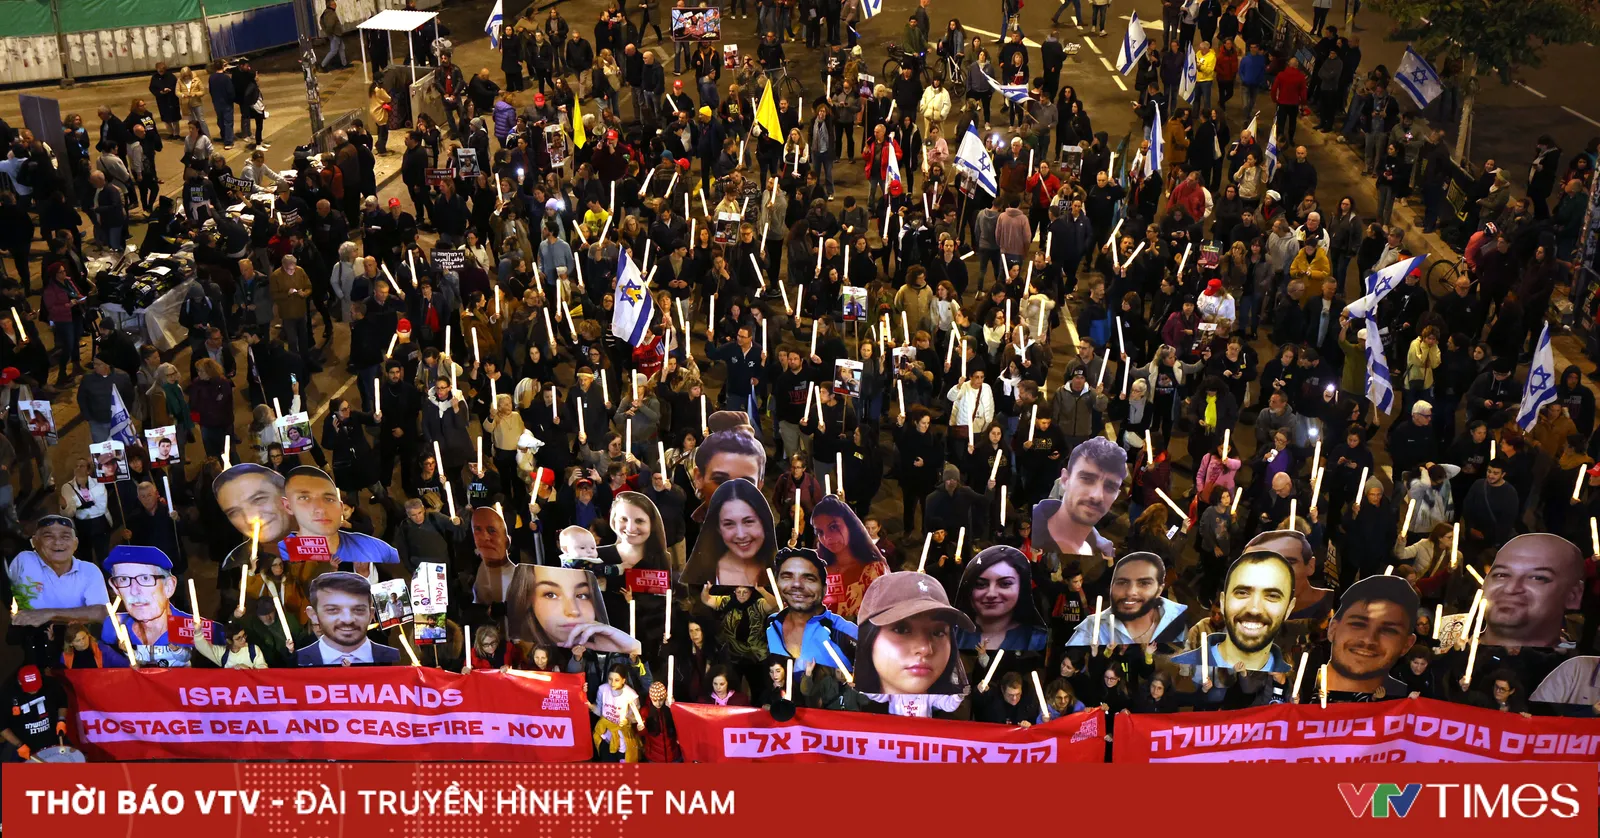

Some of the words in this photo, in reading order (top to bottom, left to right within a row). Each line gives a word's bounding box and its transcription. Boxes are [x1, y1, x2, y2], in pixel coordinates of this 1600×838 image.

[300, 538, 325, 546] עדיין
[642, 570, 667, 578] עדיין
[20, 695, 46, 715] די
[179, 685, 297, 706] ISRAEL
[305, 684, 463, 708] DEMANDS
[82, 718, 203, 736] HOSTAGE
[210, 719, 278, 735] DEAL
[285, 719, 340, 735] AND
[346, 718, 484, 738] CEASEFIRE
[508, 721, 567, 739] NOW
[1150, 720, 1289, 752] הממשלה
[1297, 716, 1376, 740] בשבי
[1383, 713, 1491, 750] גוססים
[730, 731, 791, 754] אליי
[800, 730, 869, 756] זועק
[878, 739, 988, 763] אחיותיי
[997, 745, 1052, 763] קול
